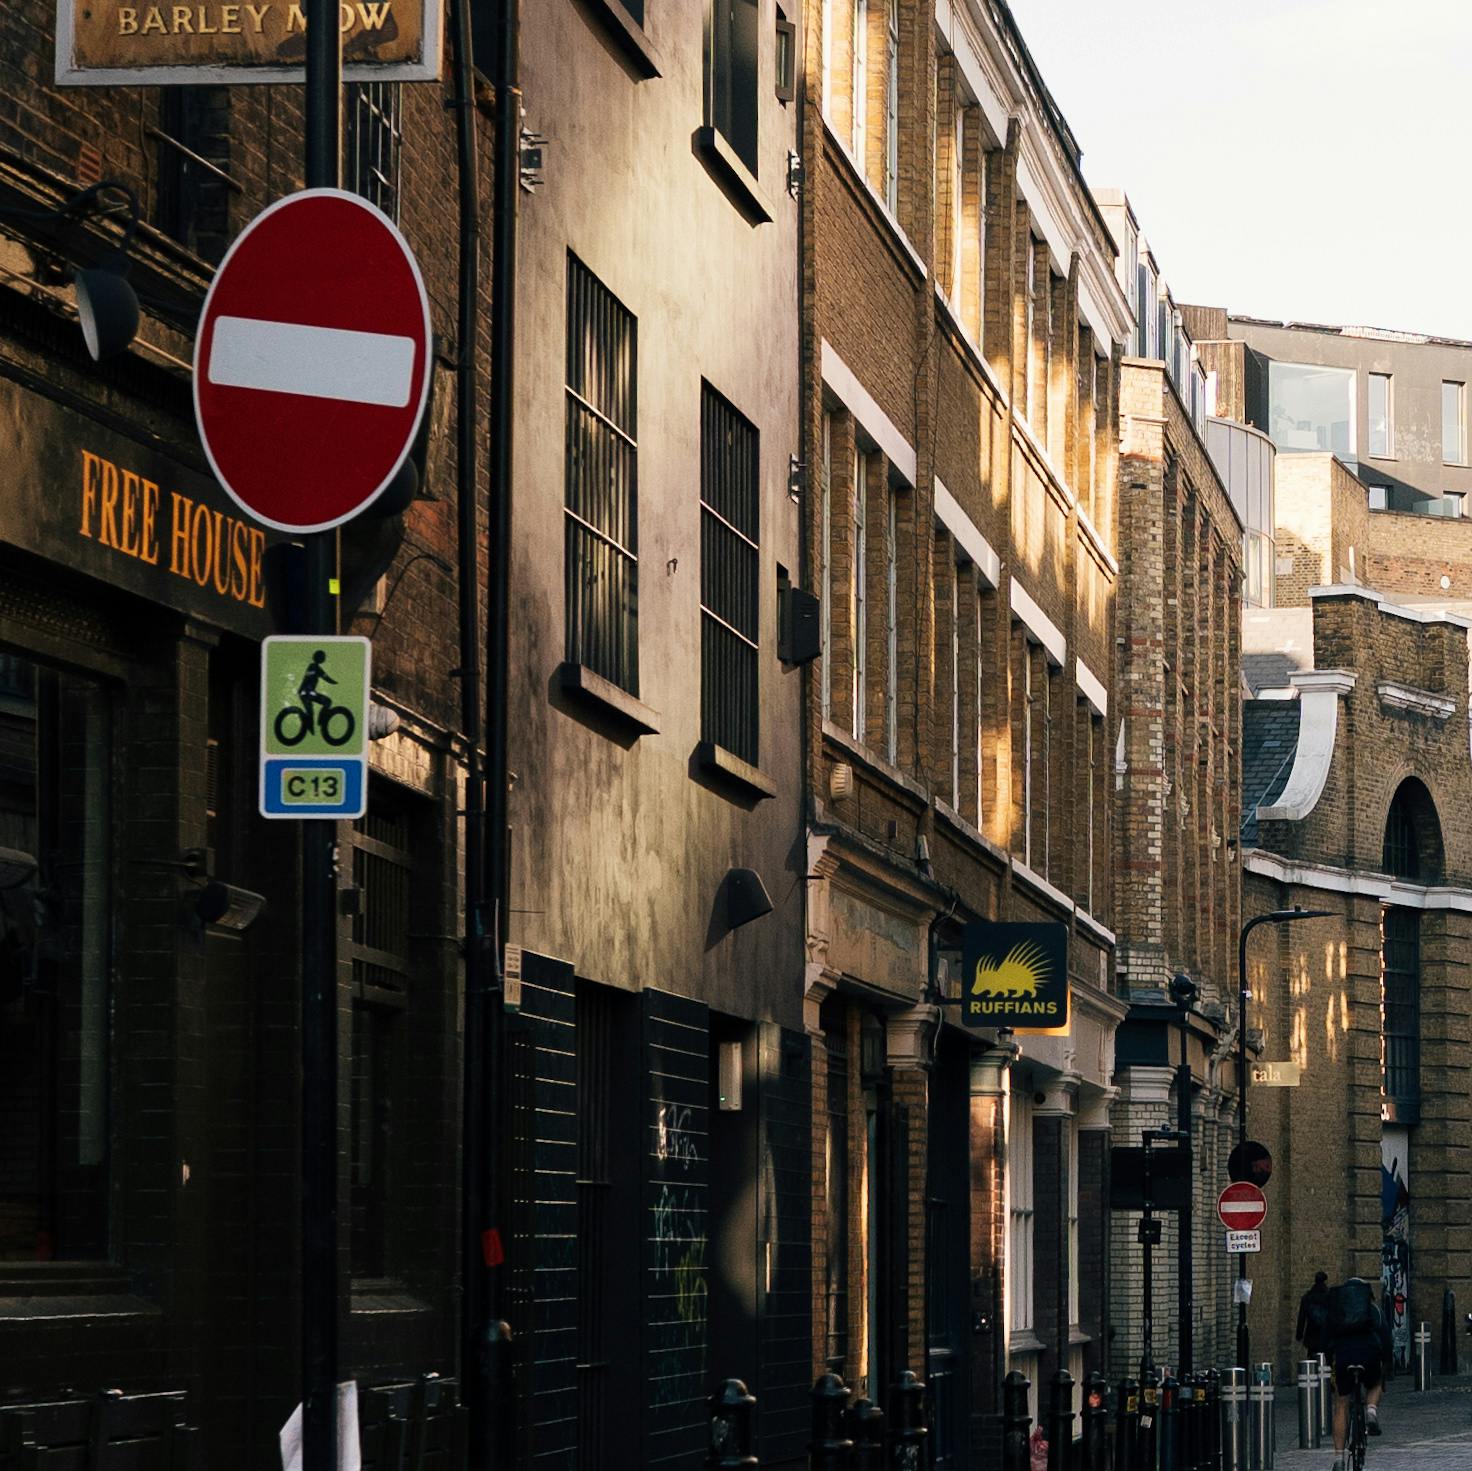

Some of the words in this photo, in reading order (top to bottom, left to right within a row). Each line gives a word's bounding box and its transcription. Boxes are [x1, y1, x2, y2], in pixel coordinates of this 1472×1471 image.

[118, 3, 271, 36] BARLEY
[79, 448, 160, 565] FREE
[169, 491, 266, 608] HOUSE
[287, 775, 339, 798] C13
[970, 1001, 1058, 1014] RUFFIANS
[1252, 1064, 1281, 1082] tala
[1229, 1233, 1257, 1241] Except
[1231, 1241, 1256, 1250] cycles
